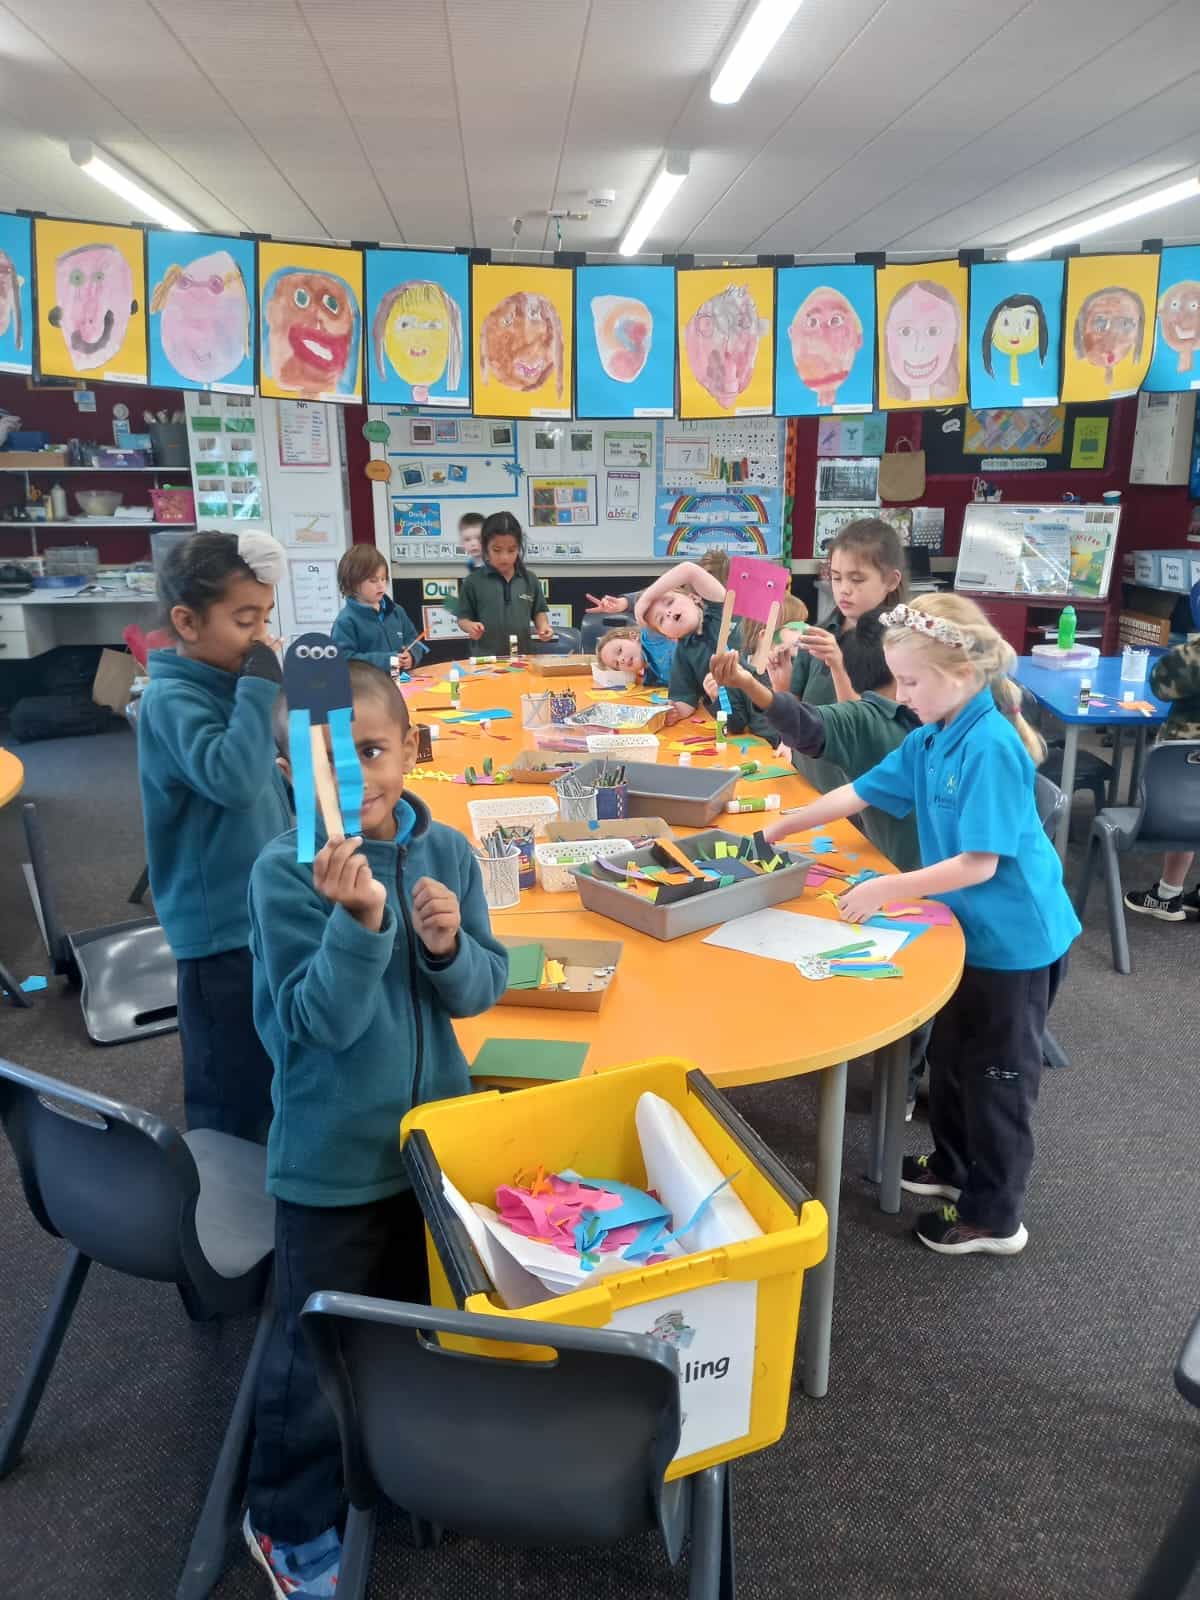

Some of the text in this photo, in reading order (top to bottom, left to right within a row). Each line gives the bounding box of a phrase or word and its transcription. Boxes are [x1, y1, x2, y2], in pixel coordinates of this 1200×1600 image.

[408, 511, 427, 520] Daily
[307, 564, 320, 574] Qq
[425, 582, 457, 597] Our
[680, 1356, 731, 1384] ling
